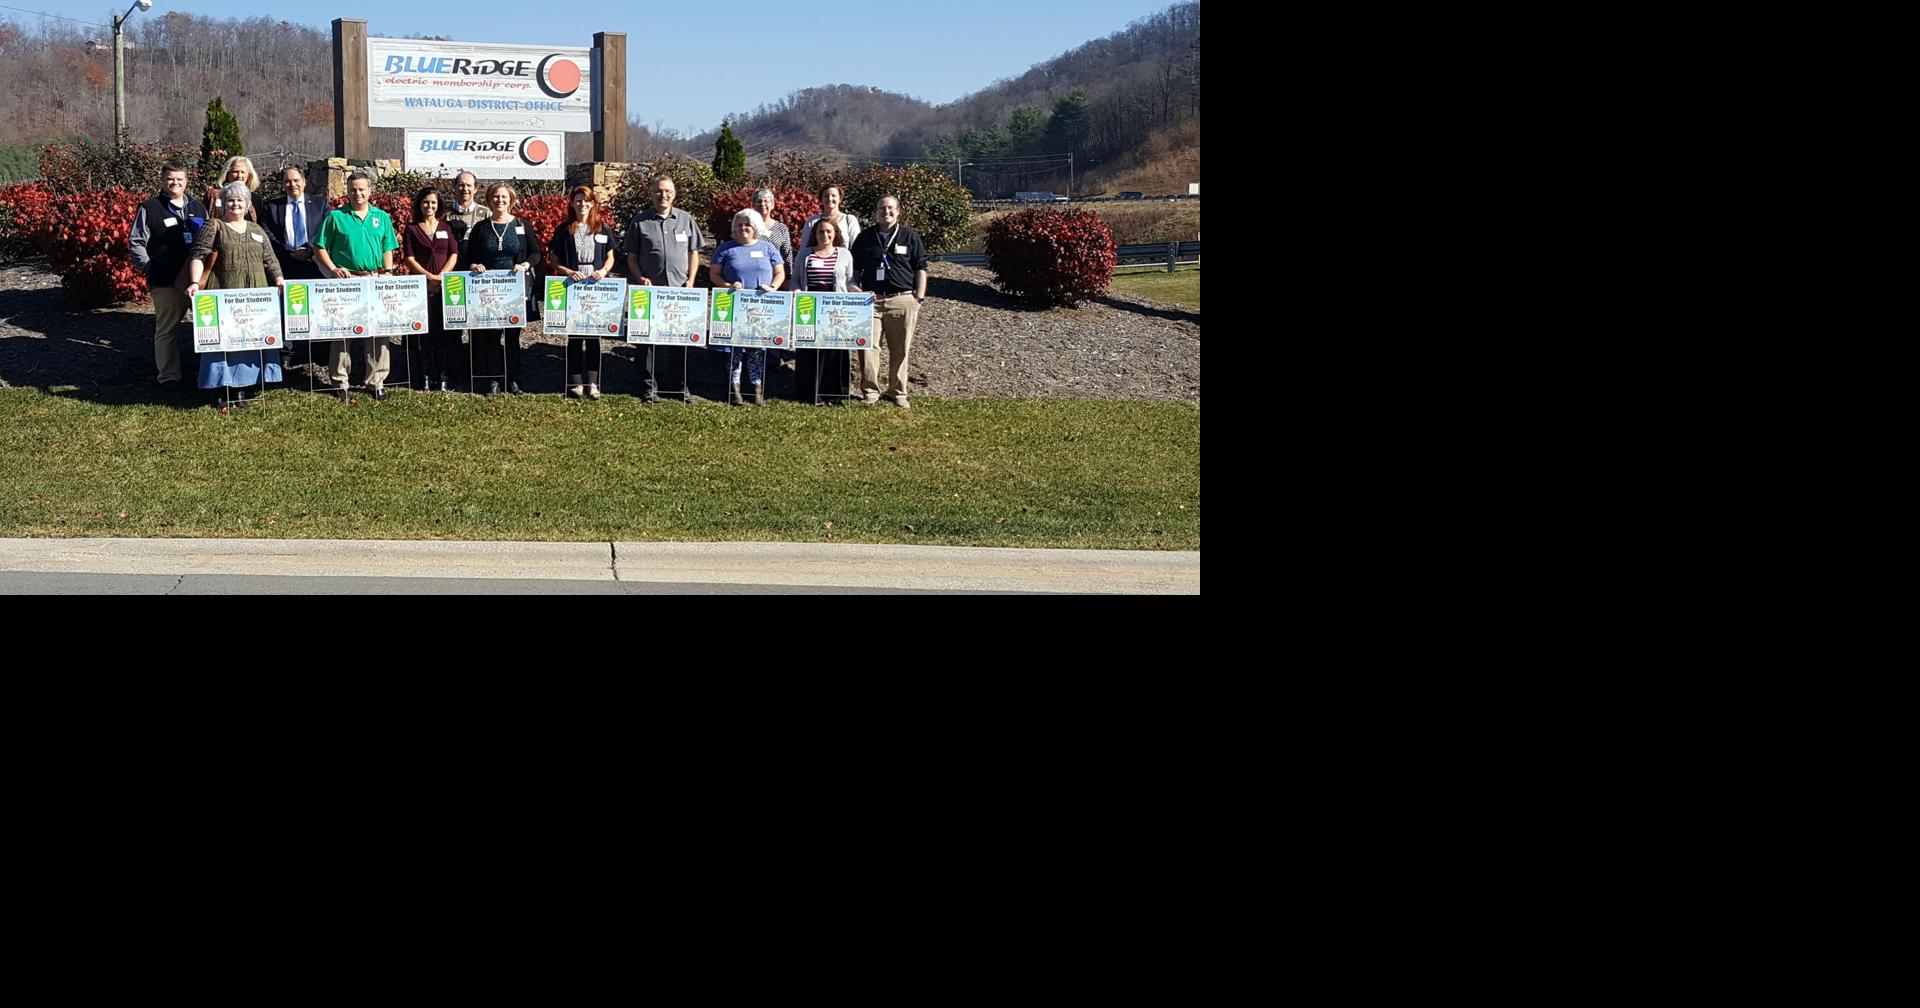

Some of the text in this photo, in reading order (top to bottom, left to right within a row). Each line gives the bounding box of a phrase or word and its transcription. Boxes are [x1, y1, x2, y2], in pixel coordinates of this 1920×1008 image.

[385, 77, 532, 90] electric membership corp.
[404, 97, 564, 112] WATAUGA DISTRICT OFFICE
